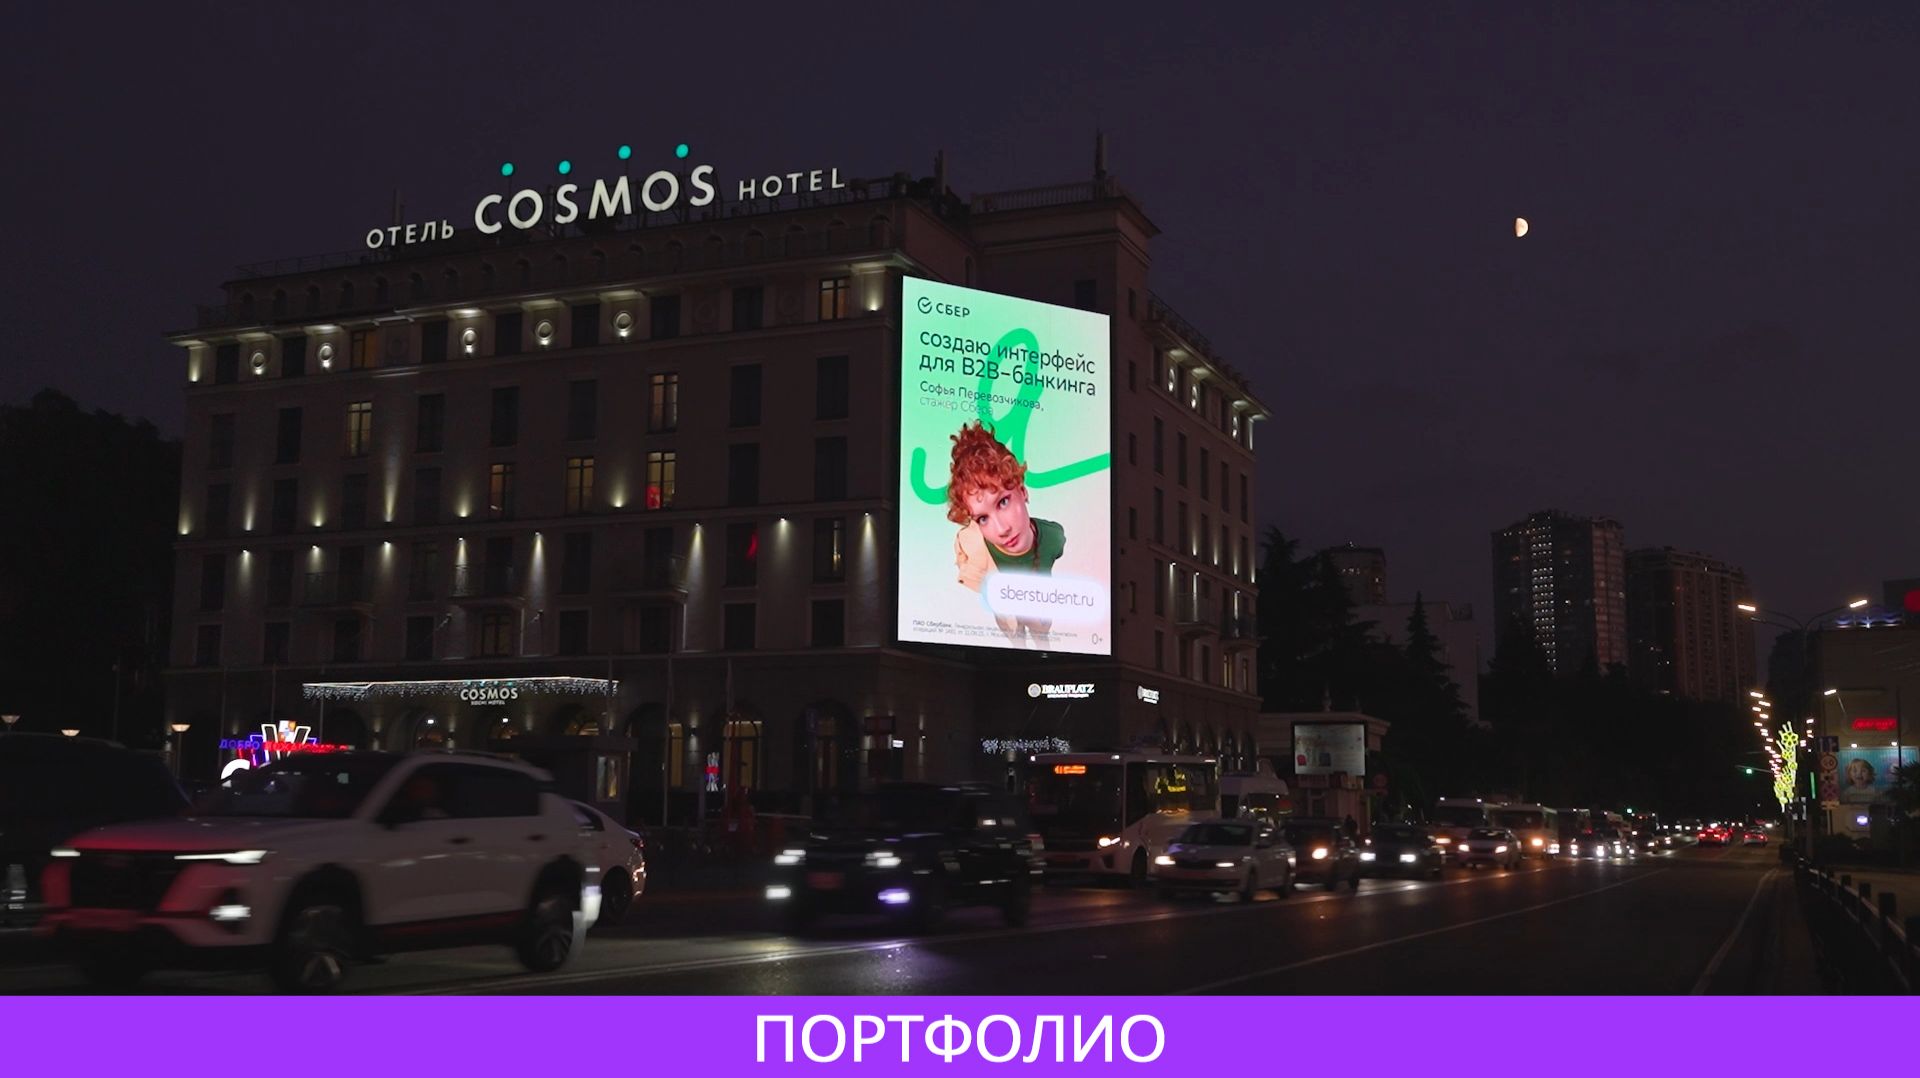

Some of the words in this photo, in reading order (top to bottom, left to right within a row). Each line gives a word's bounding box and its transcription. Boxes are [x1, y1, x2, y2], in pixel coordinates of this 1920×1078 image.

[366, 218, 455, 249] ОТЕЛЬ
[474, 164, 715, 235] COSMOS
[738, 168, 845, 202] HOTEL
[935, 302, 971, 318] СБЕР
[919, 331, 992, 356] создаю
[997, 345, 1096, 374] интерфейс
[919, 354, 955, 373] для
[919, 380, 955, 396] Софья
[958, 386, 1045, 412] Перевозчикова,
[960, 400, 995, 416] Сбера
[1000, 585, 1094, 607] sberstudent.ru
[1091, 632, 1103, 645] 0+
[460, 687, 518, 701] COSMOS
[219, 738, 261, 751] ДОБРО
